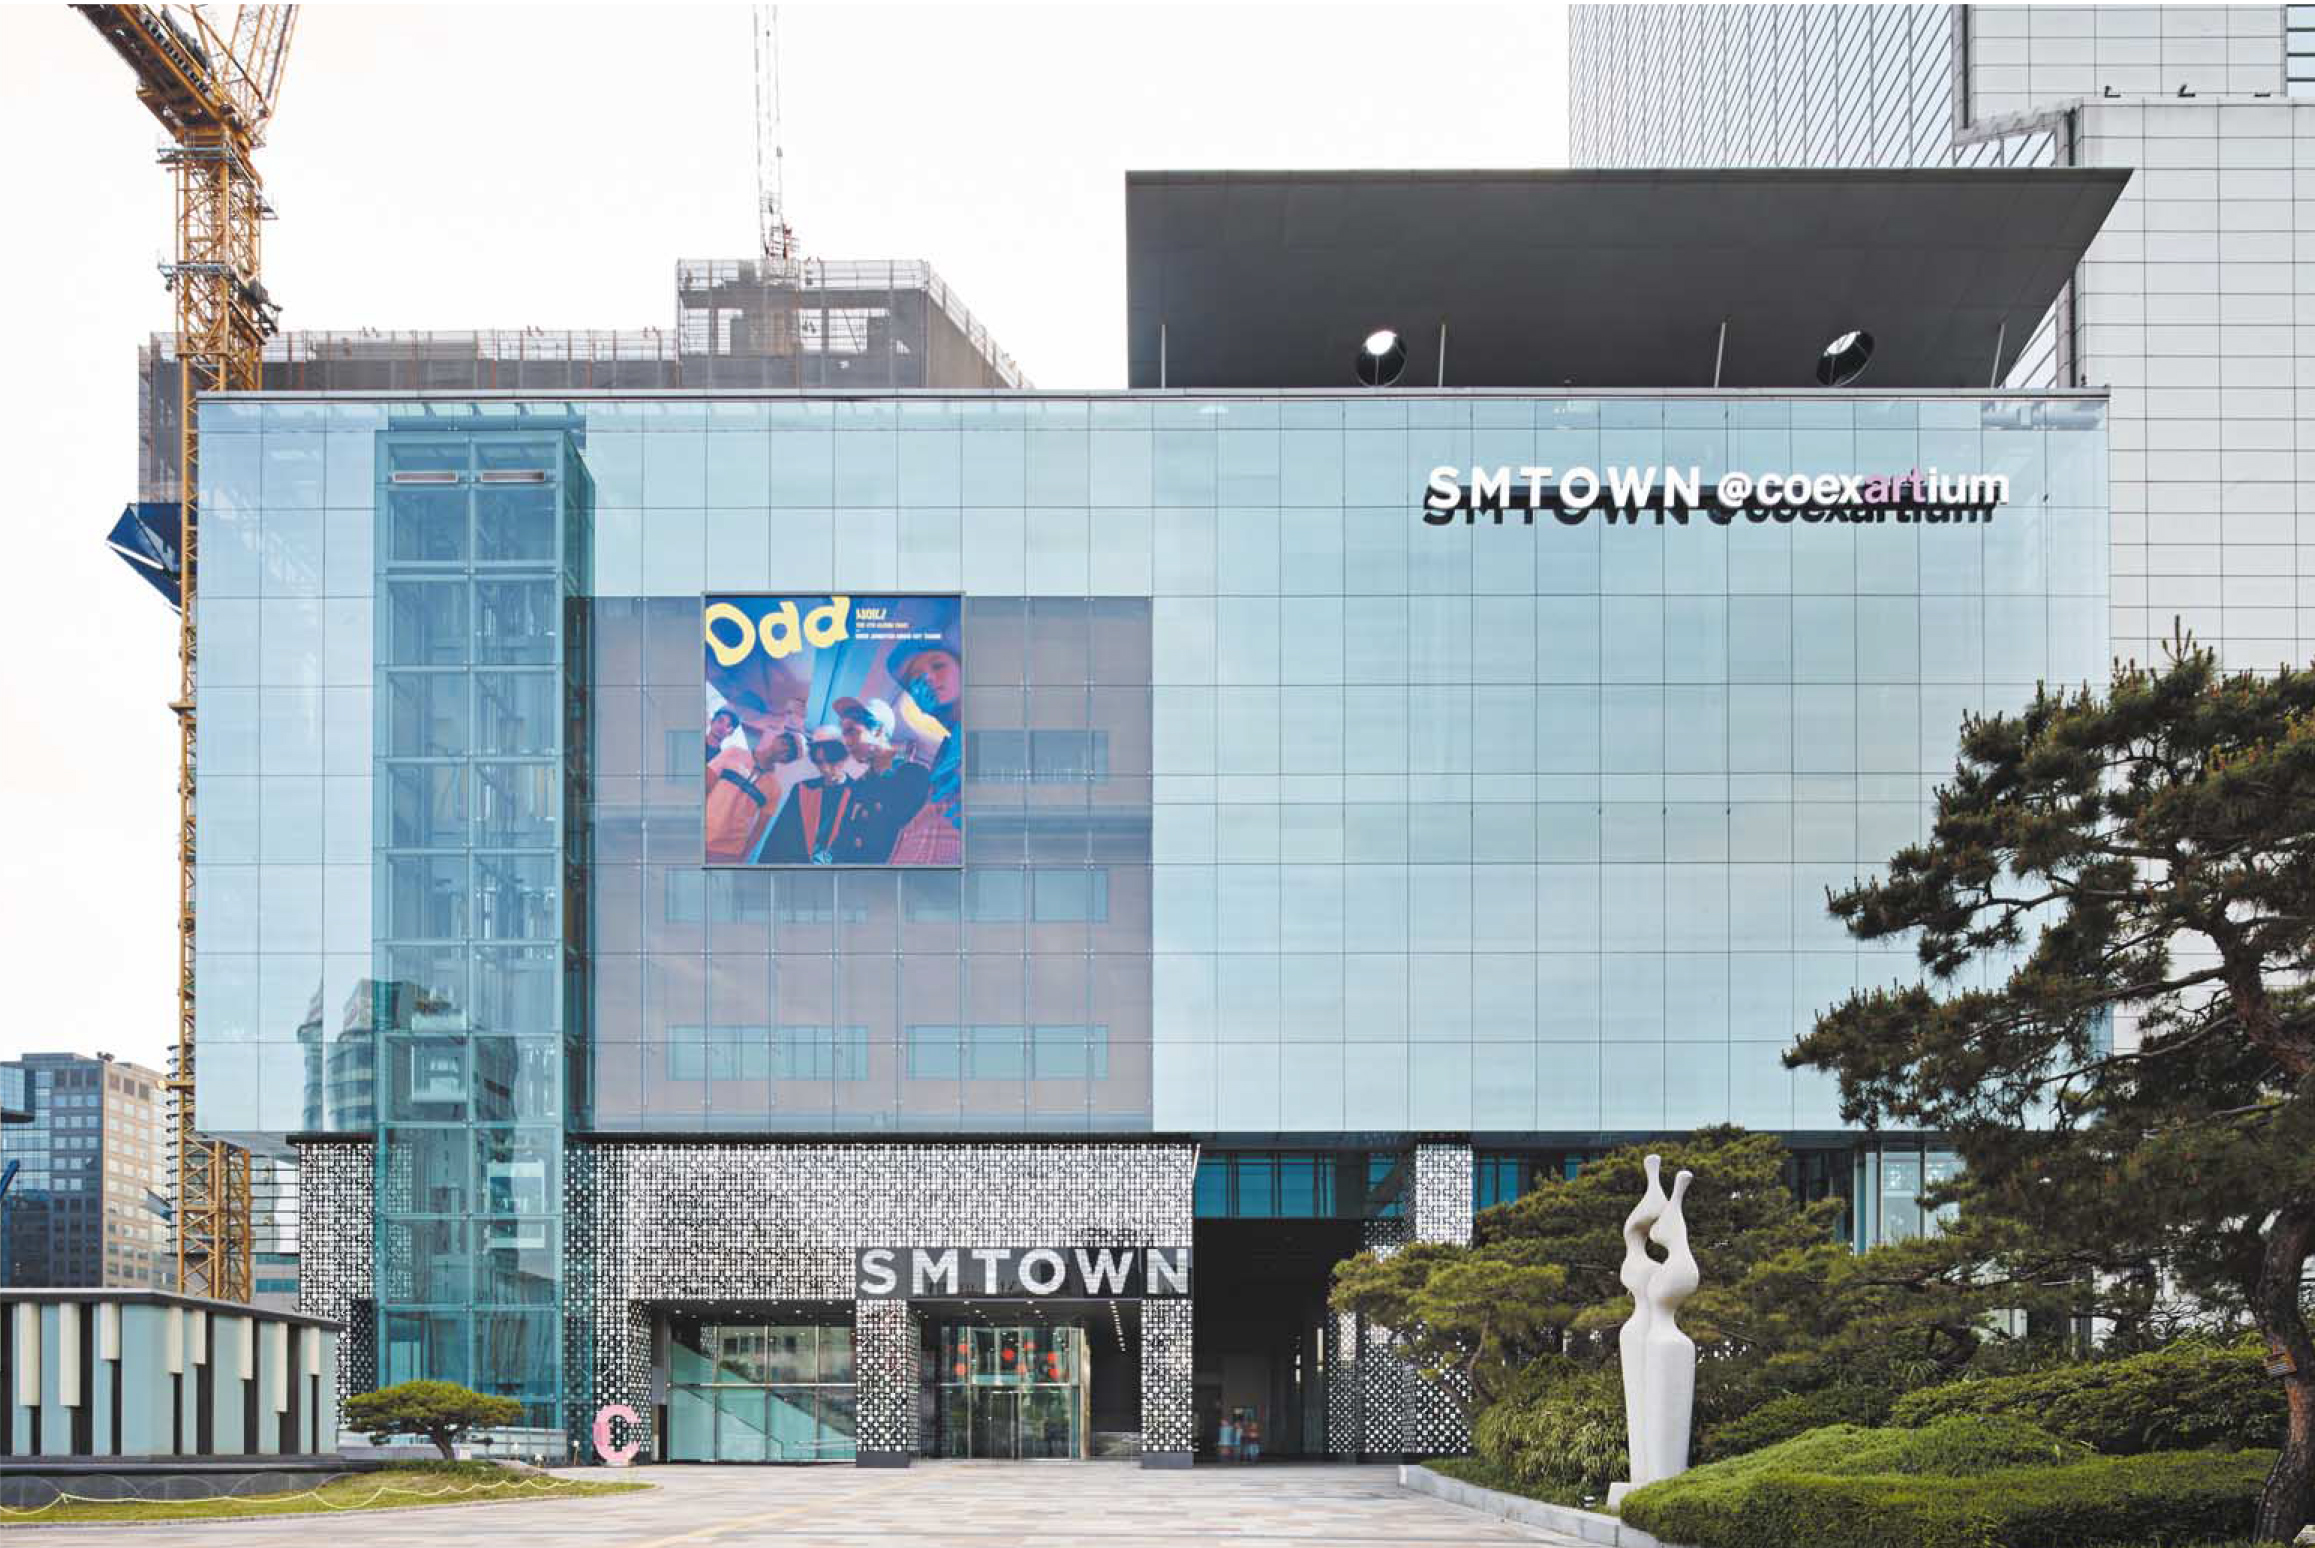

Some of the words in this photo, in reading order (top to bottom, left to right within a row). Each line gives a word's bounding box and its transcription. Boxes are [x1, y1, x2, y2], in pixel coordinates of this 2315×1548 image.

[1427, 467, 1701, 508] SMTOWN
[1717, 468, 2009, 506] @coexartium
[706, 596, 850, 666] Odd
[860, 1248, 1188, 1295] SMTOWN
[592, 1404, 641, 1462] C
